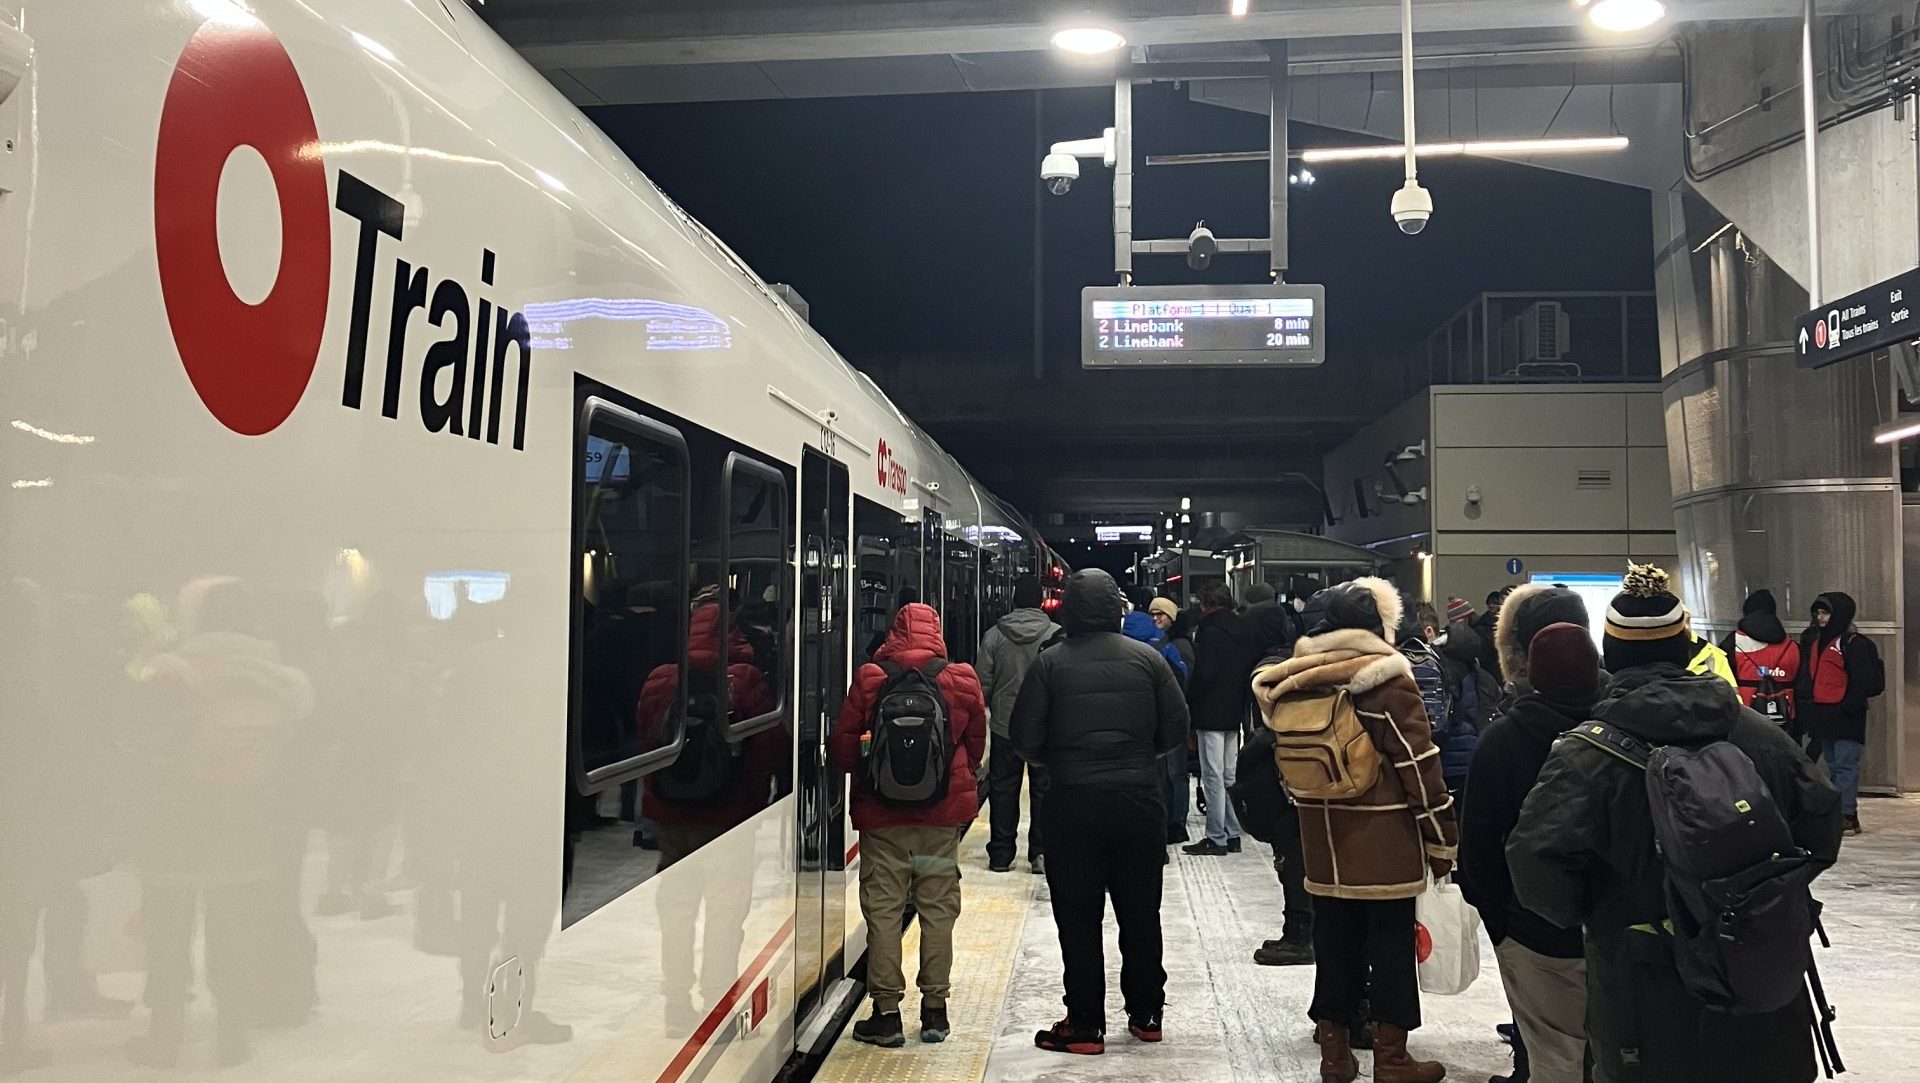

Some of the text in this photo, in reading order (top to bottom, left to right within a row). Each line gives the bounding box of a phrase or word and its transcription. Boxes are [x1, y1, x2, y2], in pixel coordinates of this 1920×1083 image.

[1890, 289, 1902, 303] Exit
[335, 168, 531, 452] Train
[1132, 303, 1192, 315] Platform
[1229, 302, 1257, 315] Quai
[1841, 304, 1866, 322] All Trains
[1891, 307, 1909, 323] Sortie
[1099, 317, 1310, 333] 2 Limebank 8 min
[1842, 319, 1879, 340] Tous les trains
[1099, 333, 1310, 348] 2 Limebank 20 min
